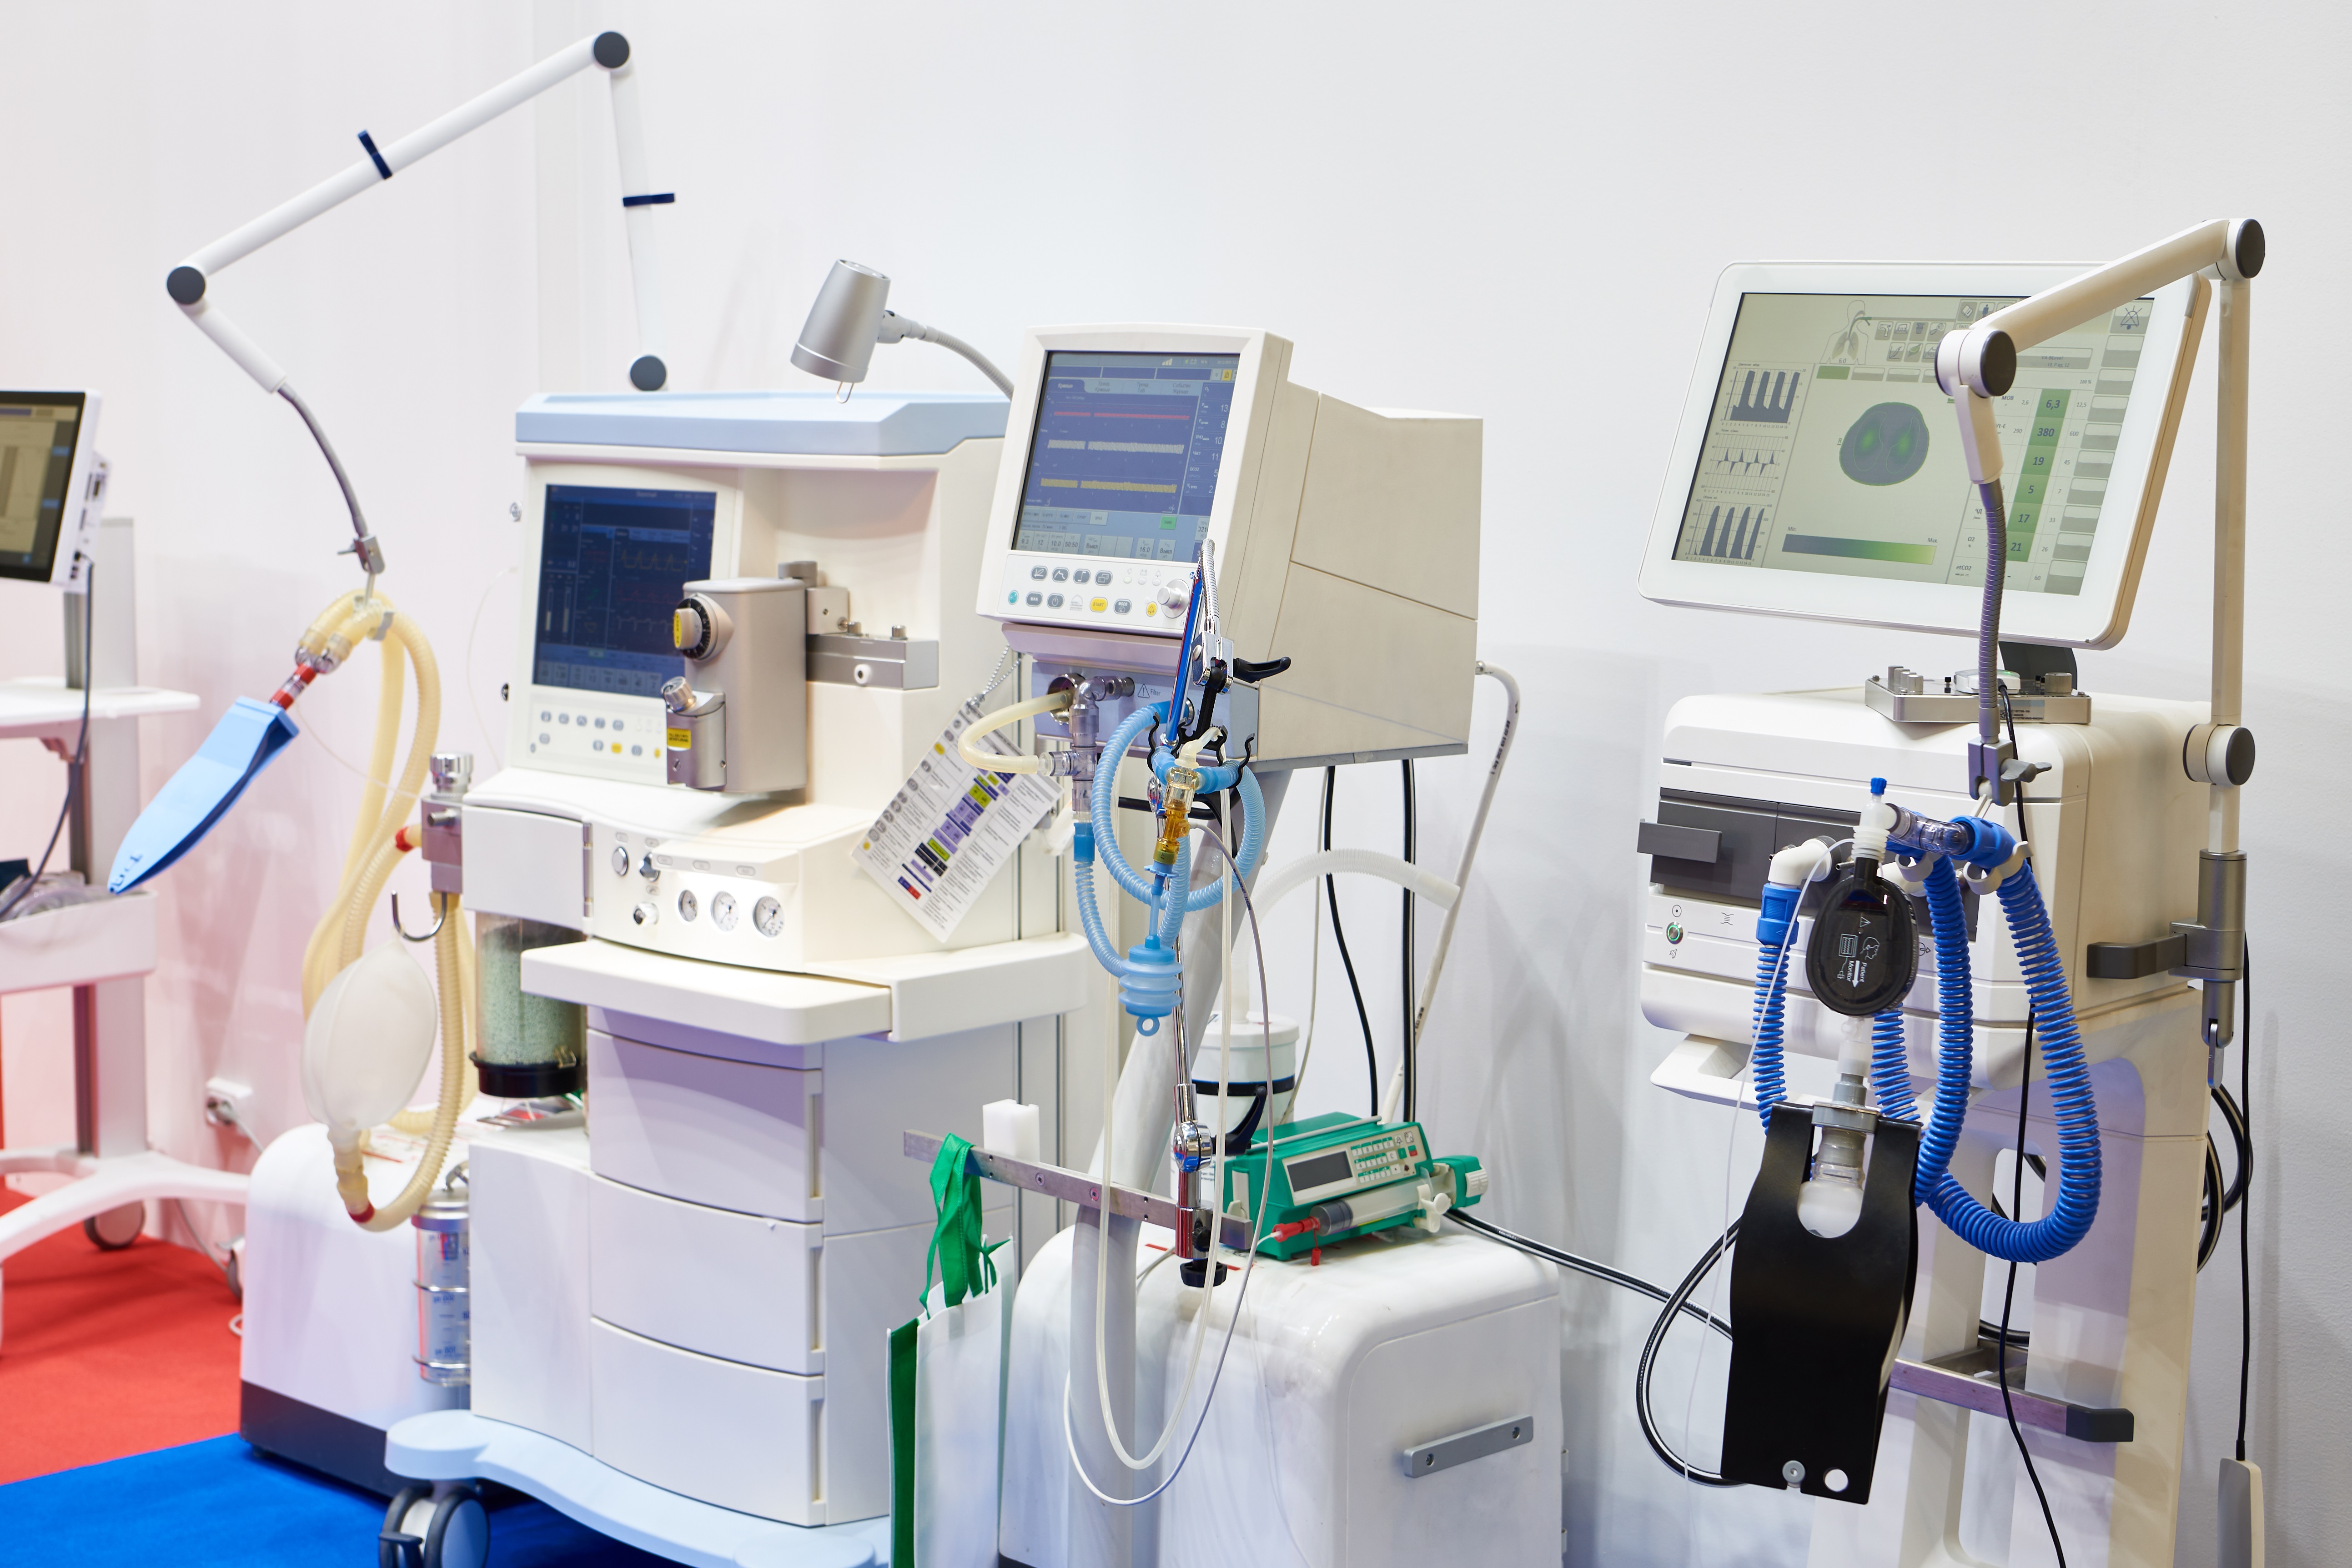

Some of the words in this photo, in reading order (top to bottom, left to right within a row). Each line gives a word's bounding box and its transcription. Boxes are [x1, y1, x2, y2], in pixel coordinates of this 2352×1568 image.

[2046, 400, 2060, 410] 6,3
[2037, 428, 2055, 437] 380
[2033, 457, 2044, 465] 19
[2028, 485, 2034, 494] 5
[2018, 514, 2030, 523] 17
[2010, 543, 2021, 552] 21
[1859, 962, 1867, 982] Patient
